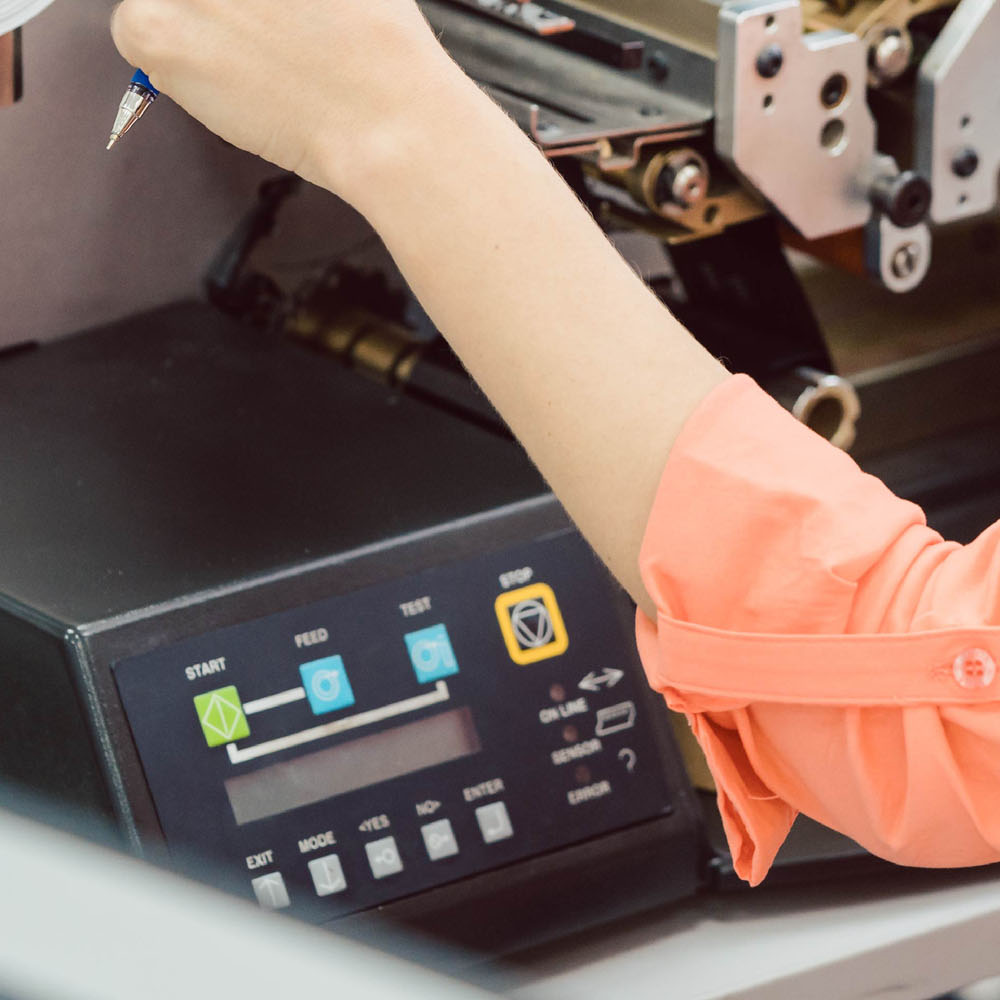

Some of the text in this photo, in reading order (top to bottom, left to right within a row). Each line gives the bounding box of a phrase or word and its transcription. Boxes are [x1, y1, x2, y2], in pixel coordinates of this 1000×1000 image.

[399, 595, 431, 617] TEST
[294, 628, 329, 648] FEED
[185, 656, 226, 681] START
[559, 697, 589, 718] LINE
[462, 778, 505, 802] ENTER
[298, 830, 337, 854] MODE
[245, 849, 274, 870] EXIT
